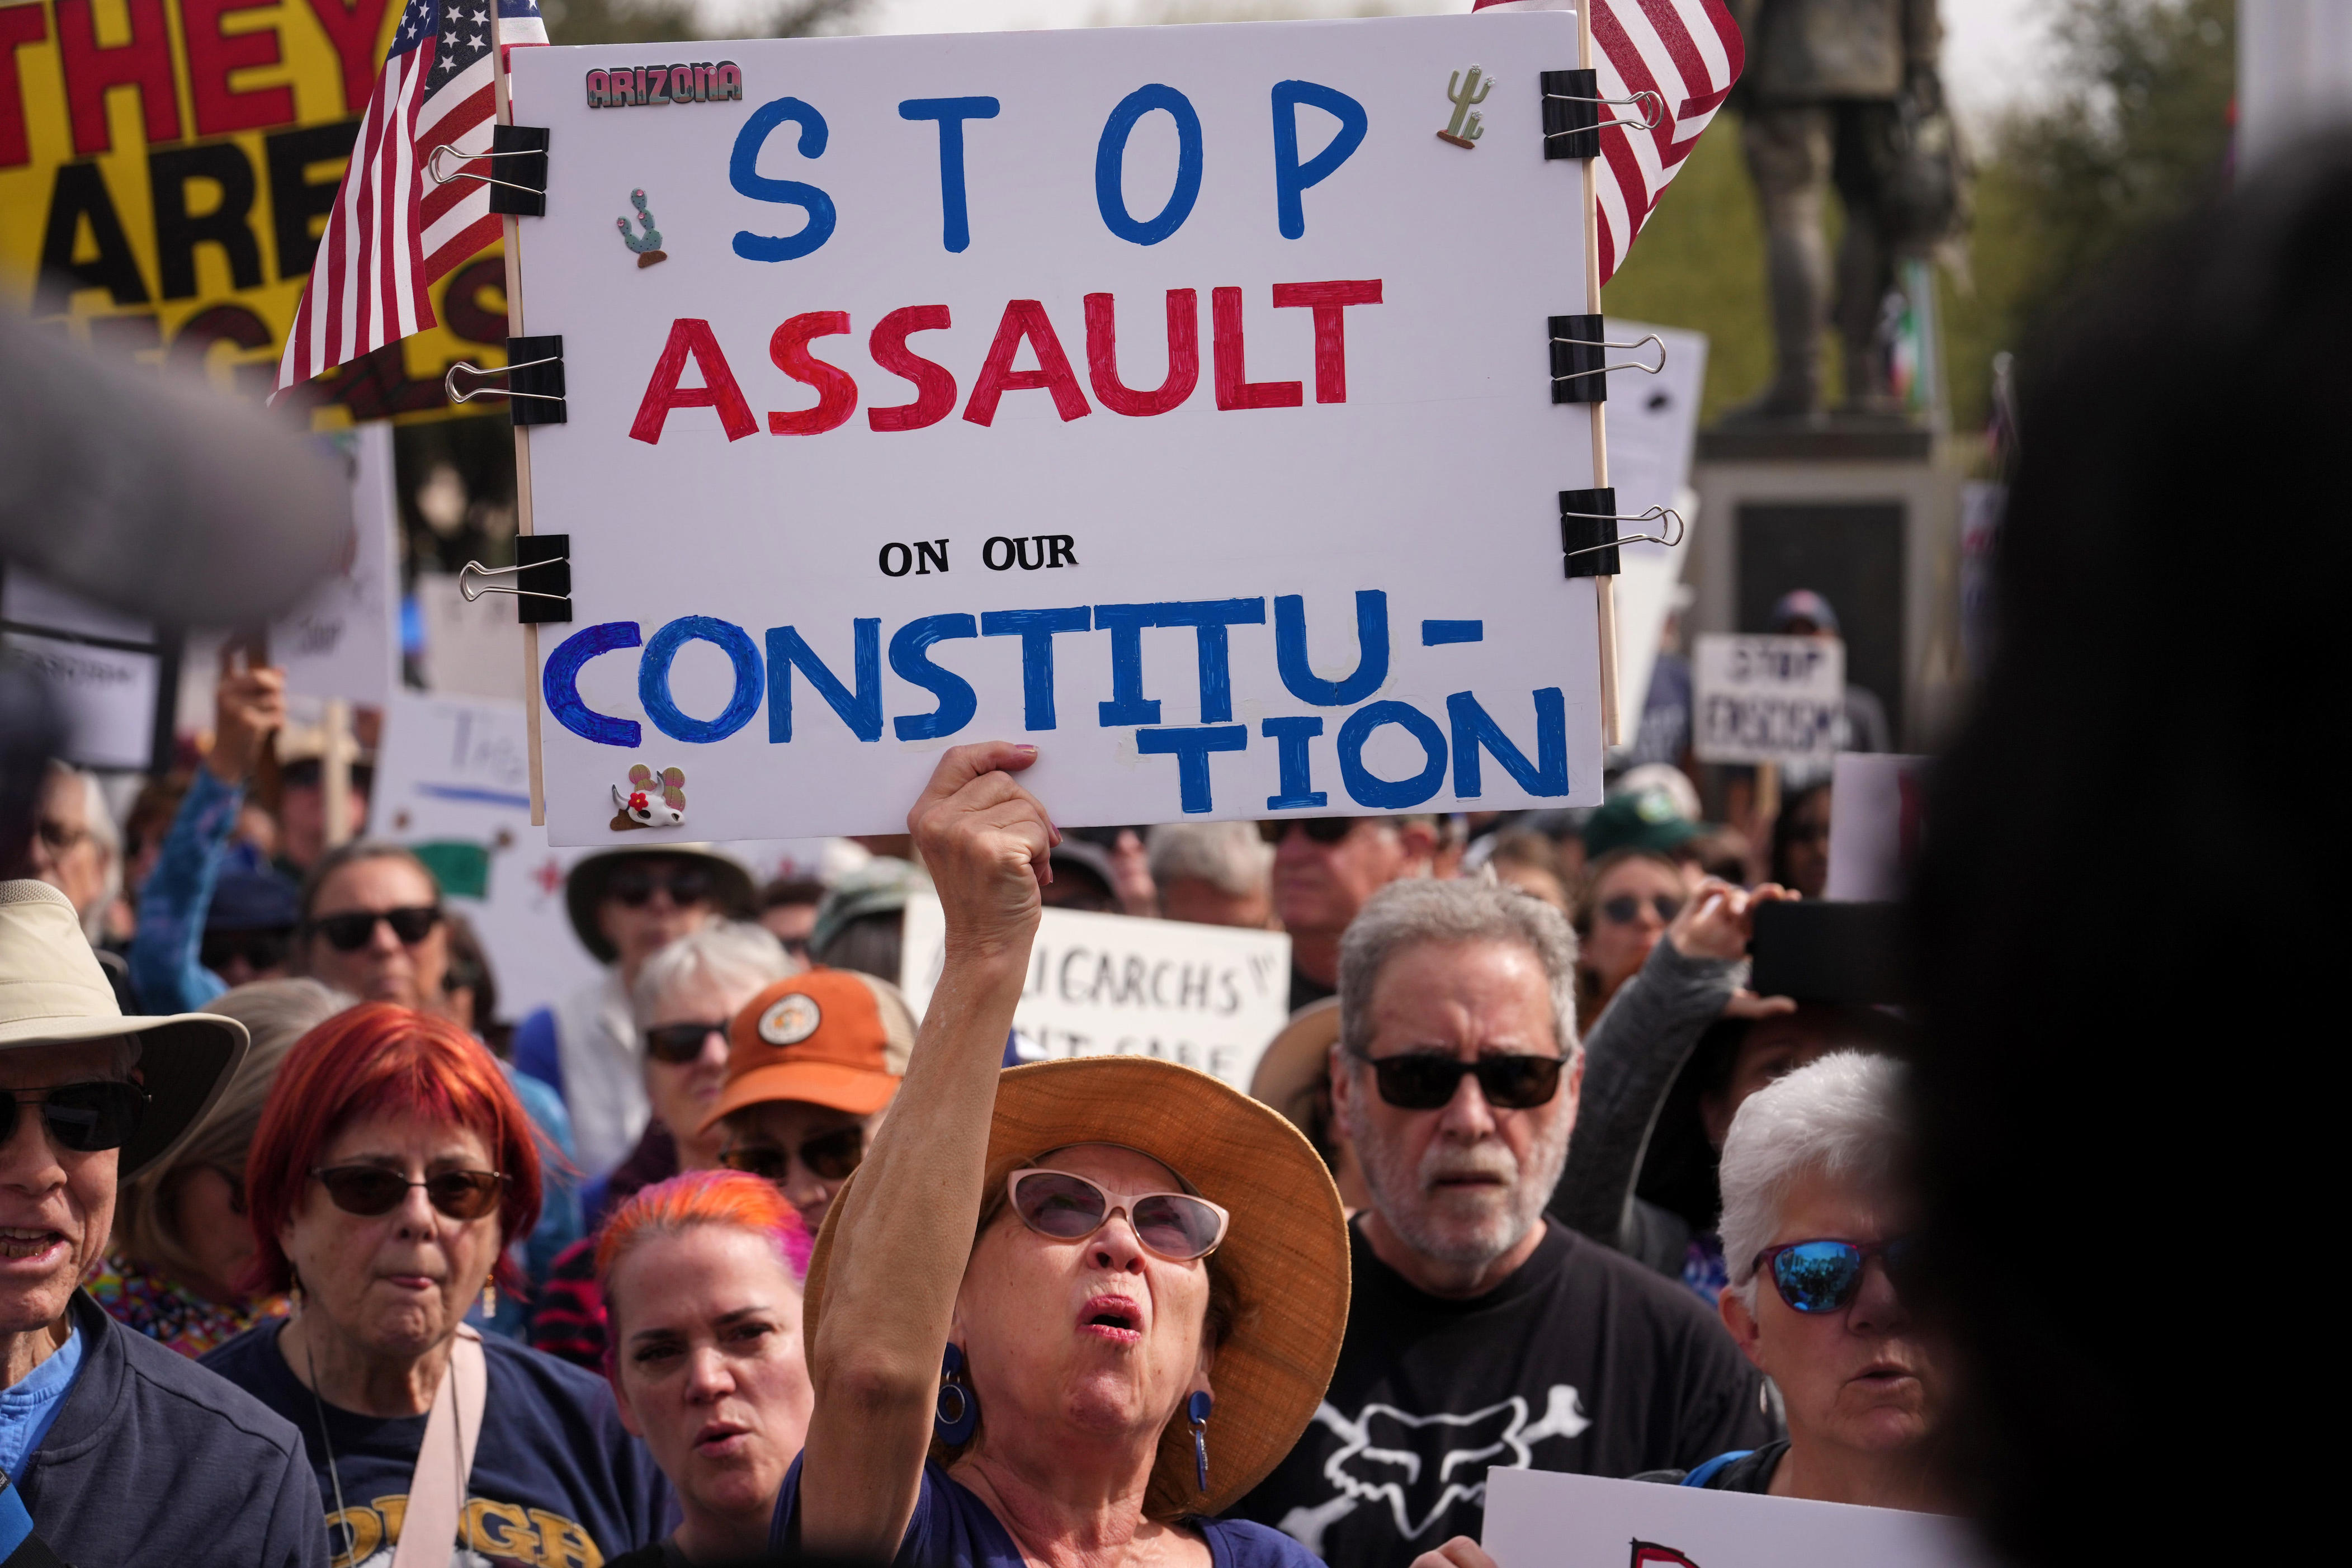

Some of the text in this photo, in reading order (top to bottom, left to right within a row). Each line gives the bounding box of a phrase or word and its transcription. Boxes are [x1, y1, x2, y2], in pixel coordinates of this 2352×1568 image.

[0, 0, 388, 167] THEY
[729, 79, 1368, 262] STOP
[629, 278, 1383, 445] ASSAULT
[879, 534, 1079, 577] ON OUR
[1135, 687, 1569, 814] TION
